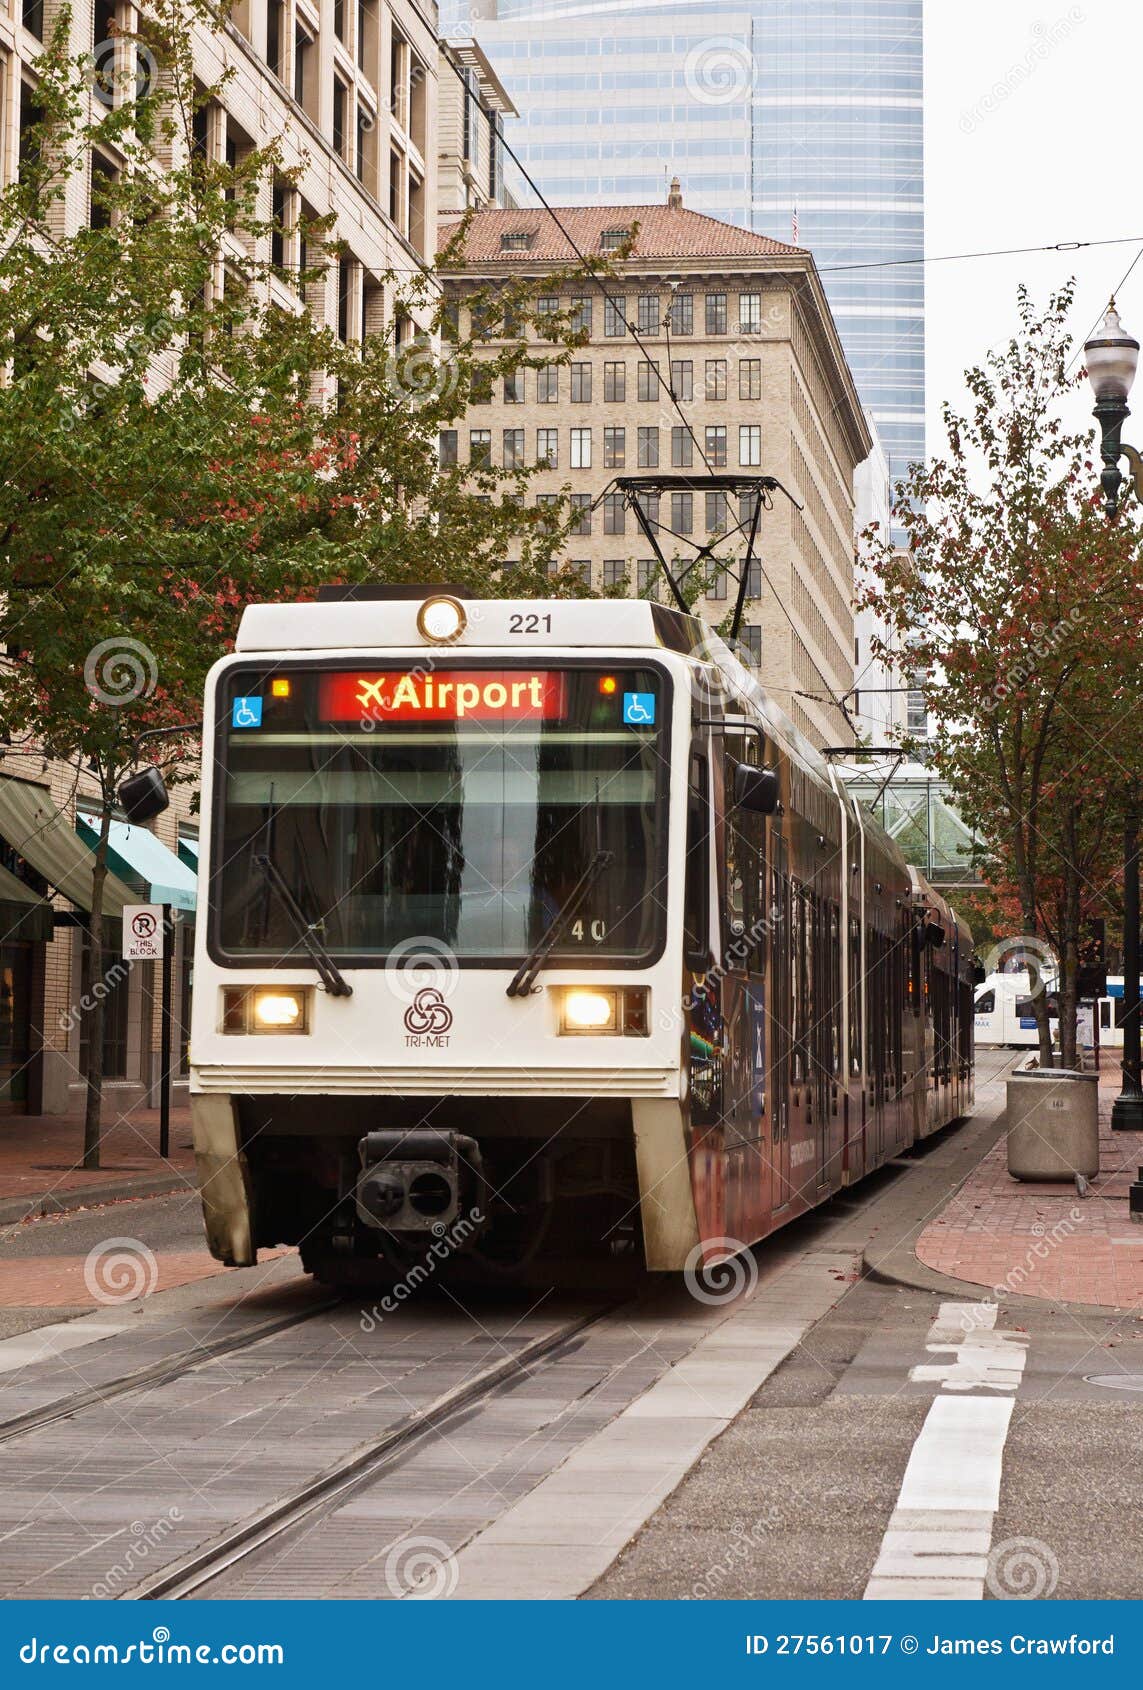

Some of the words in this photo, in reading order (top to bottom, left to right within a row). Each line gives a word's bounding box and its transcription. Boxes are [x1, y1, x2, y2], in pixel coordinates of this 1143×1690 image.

[509, 614, 551, 634] 221
[391, 676, 543, 717] Airport
[135, 940, 153, 948] THIS
[404, 1035, 451, 1048] TRI-MET
